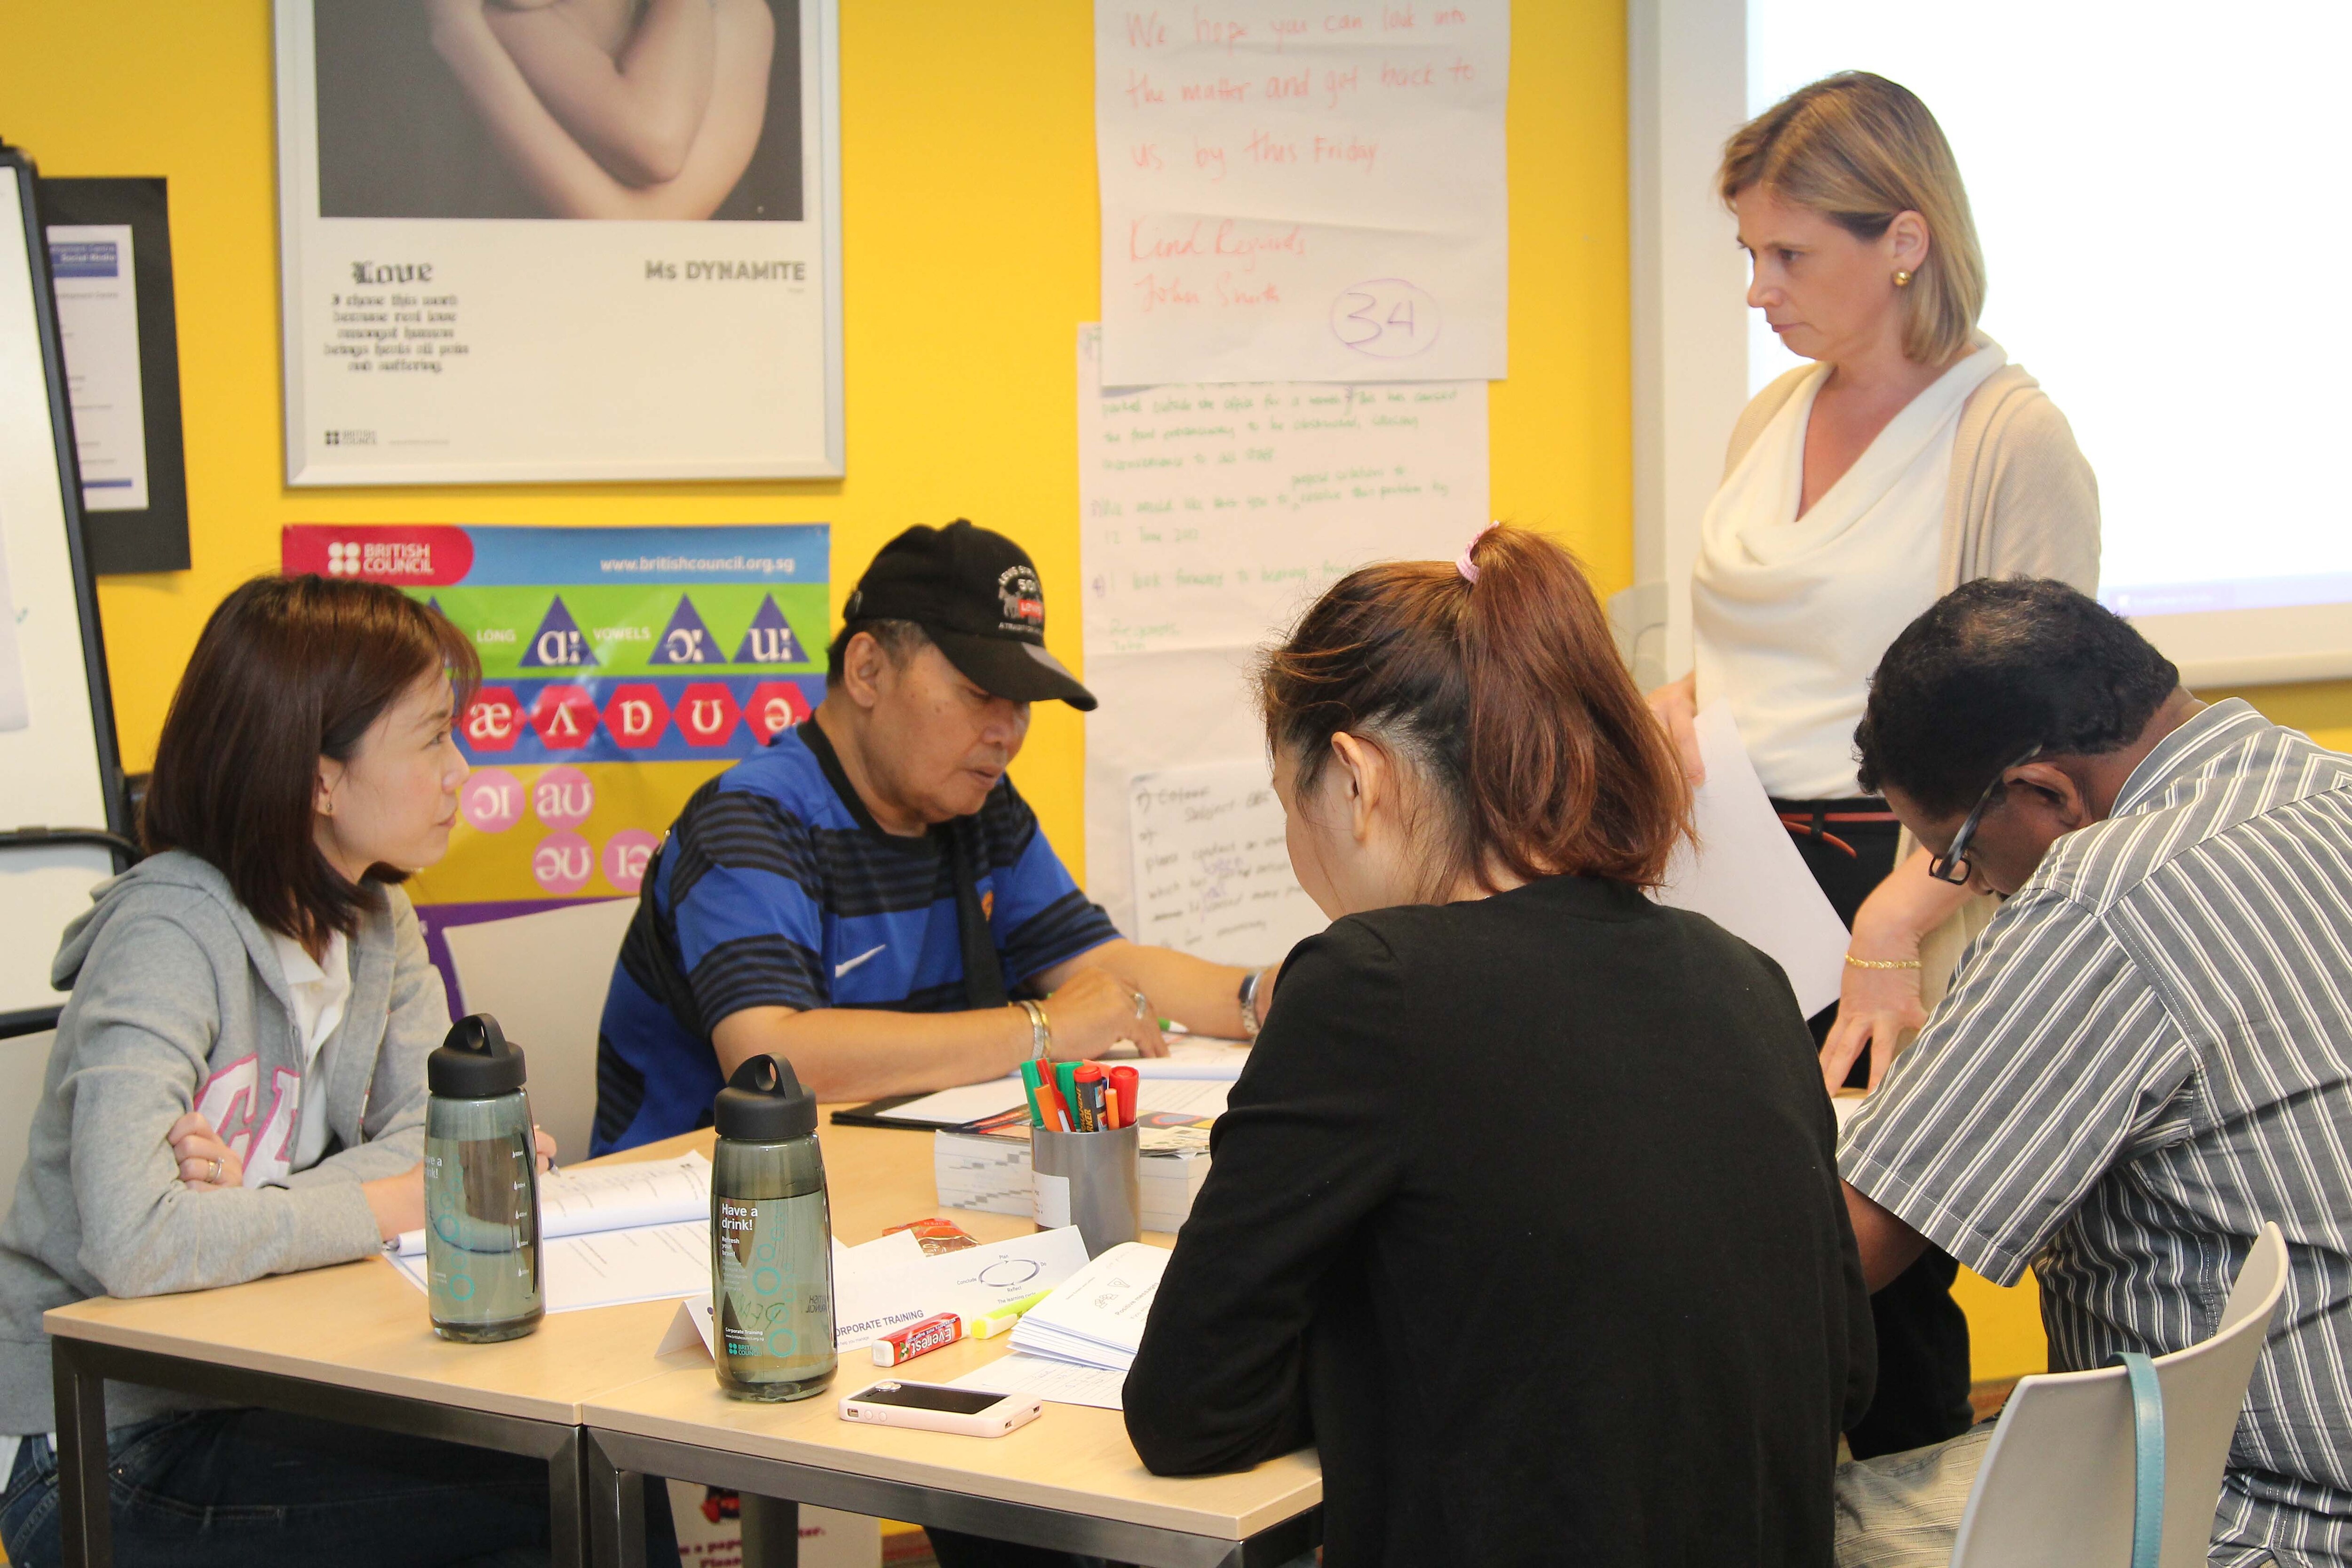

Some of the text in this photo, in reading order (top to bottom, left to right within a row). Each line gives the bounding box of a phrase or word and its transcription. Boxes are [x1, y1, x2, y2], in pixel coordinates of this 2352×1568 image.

[1271, 19, 1307, 55] you
[1324, 15, 1362, 32] can
[1266, 67, 1311, 98] and
[1449, 56, 1476, 83] to
[1130, 143, 1163, 170] us
[1193, 135, 1226, 183] by
[350, 260, 433, 285] Love
[645, 260, 806, 280] Ms DYNAMITE
[1134, 272, 1200, 312] John
[1346, 292, 1414, 346] 34
[364, 542, 431, 558] BRITISH
[363, 557, 435, 575] COUNCIL
[600, 555, 796, 575] www.britishcouncil.org.sg
[476, 629, 516, 643] LONG
[592, 627, 651, 641] VOWELS
[1084, 1108, 1094, 1132] RKER
[722, 1203, 758, 1217] Have a
[722, 1217, 753, 1231] drink!
[722, 1236, 740, 1244] Refresh
[957, 1277, 977, 1286] Conclude
[1007, 1293, 1025, 1302] learning
[835, 1309, 924, 1337] ORPORATE TRAINING
[935, 1318, 957, 1330] strawberry
[911, 1327, 952, 1356] Everest
